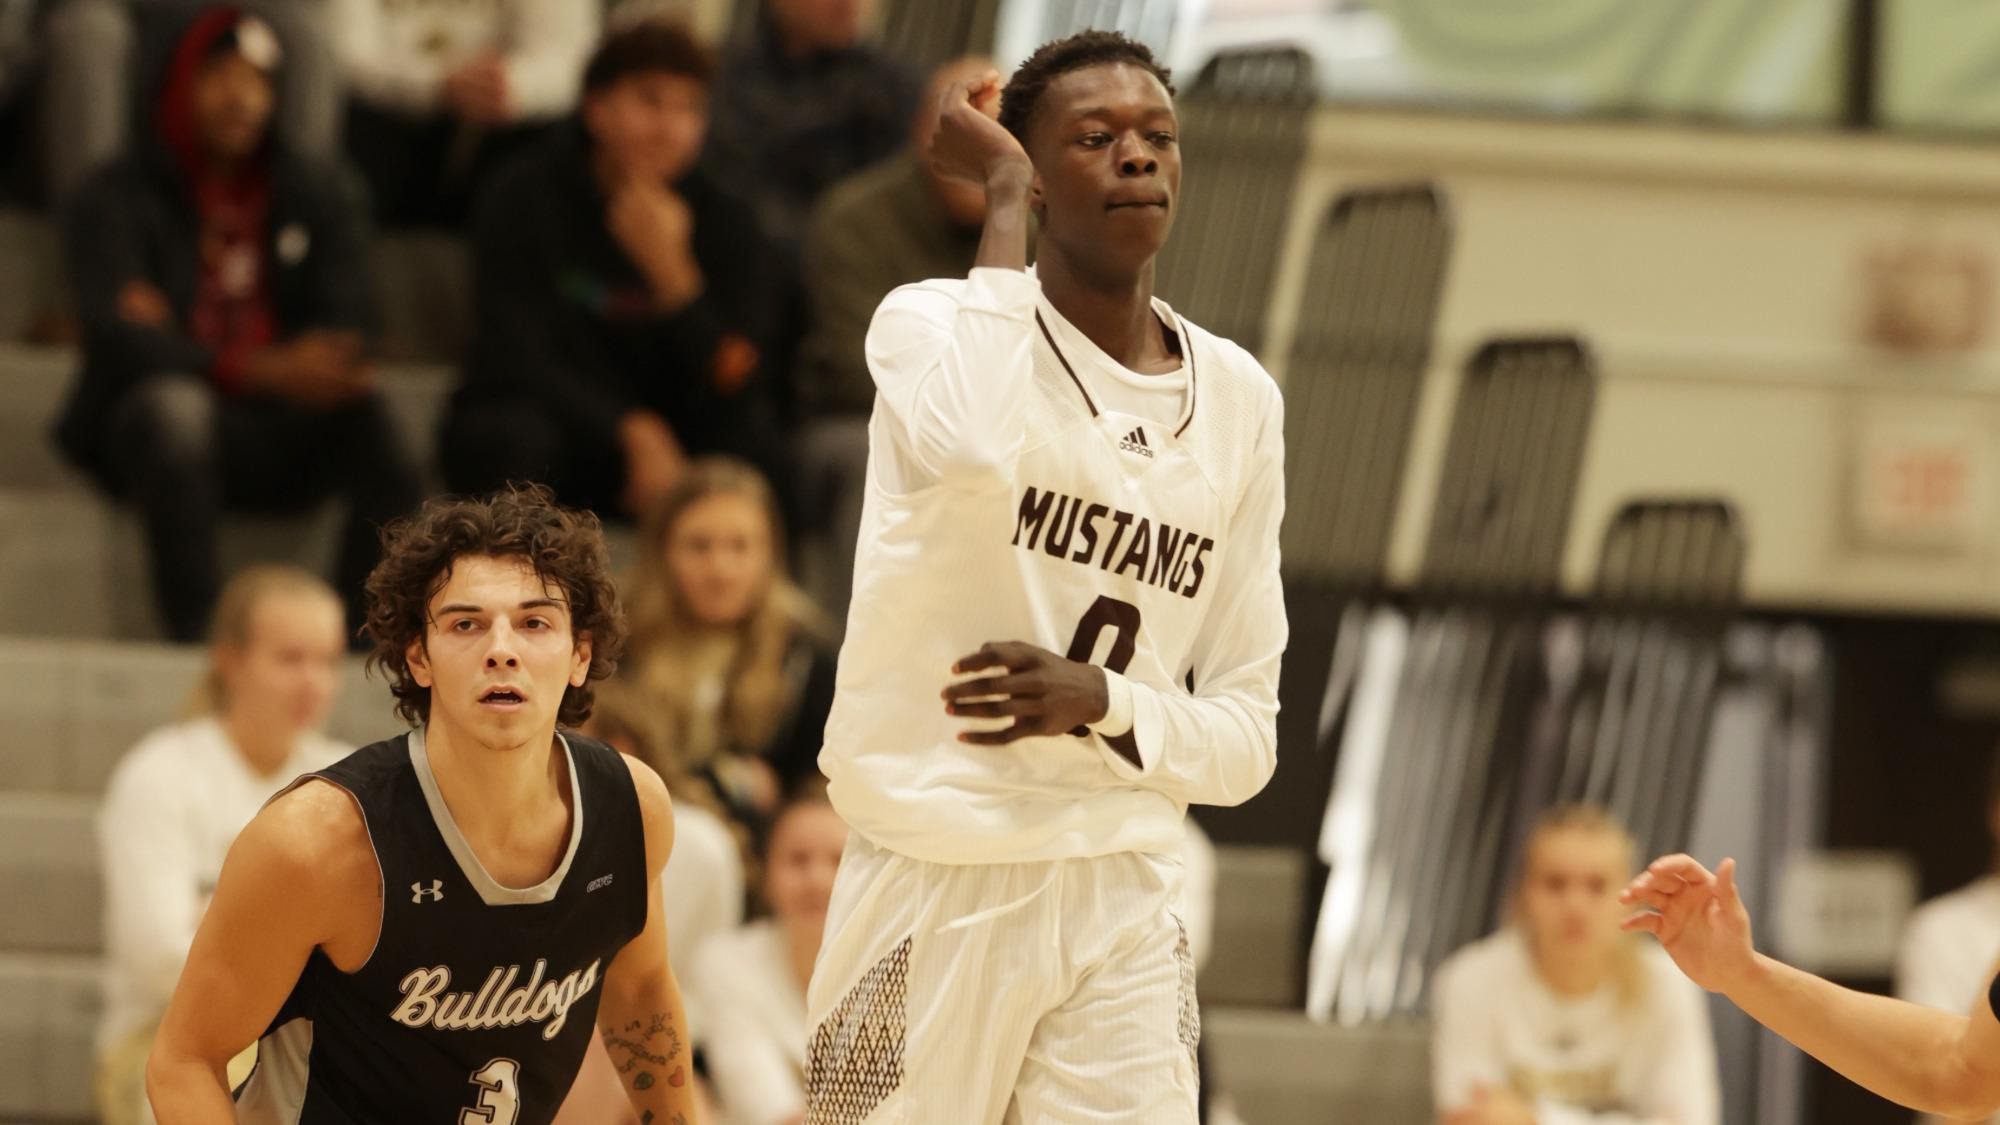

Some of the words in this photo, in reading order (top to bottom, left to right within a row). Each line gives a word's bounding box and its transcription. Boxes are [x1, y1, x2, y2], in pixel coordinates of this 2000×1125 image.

[1119, 441, 1153, 459] adidas
[1012, 486, 1215, 599] MUSTANGS
[390, 957, 601, 1041] Bulldogs
[457, 1056, 521, 1125] 3
